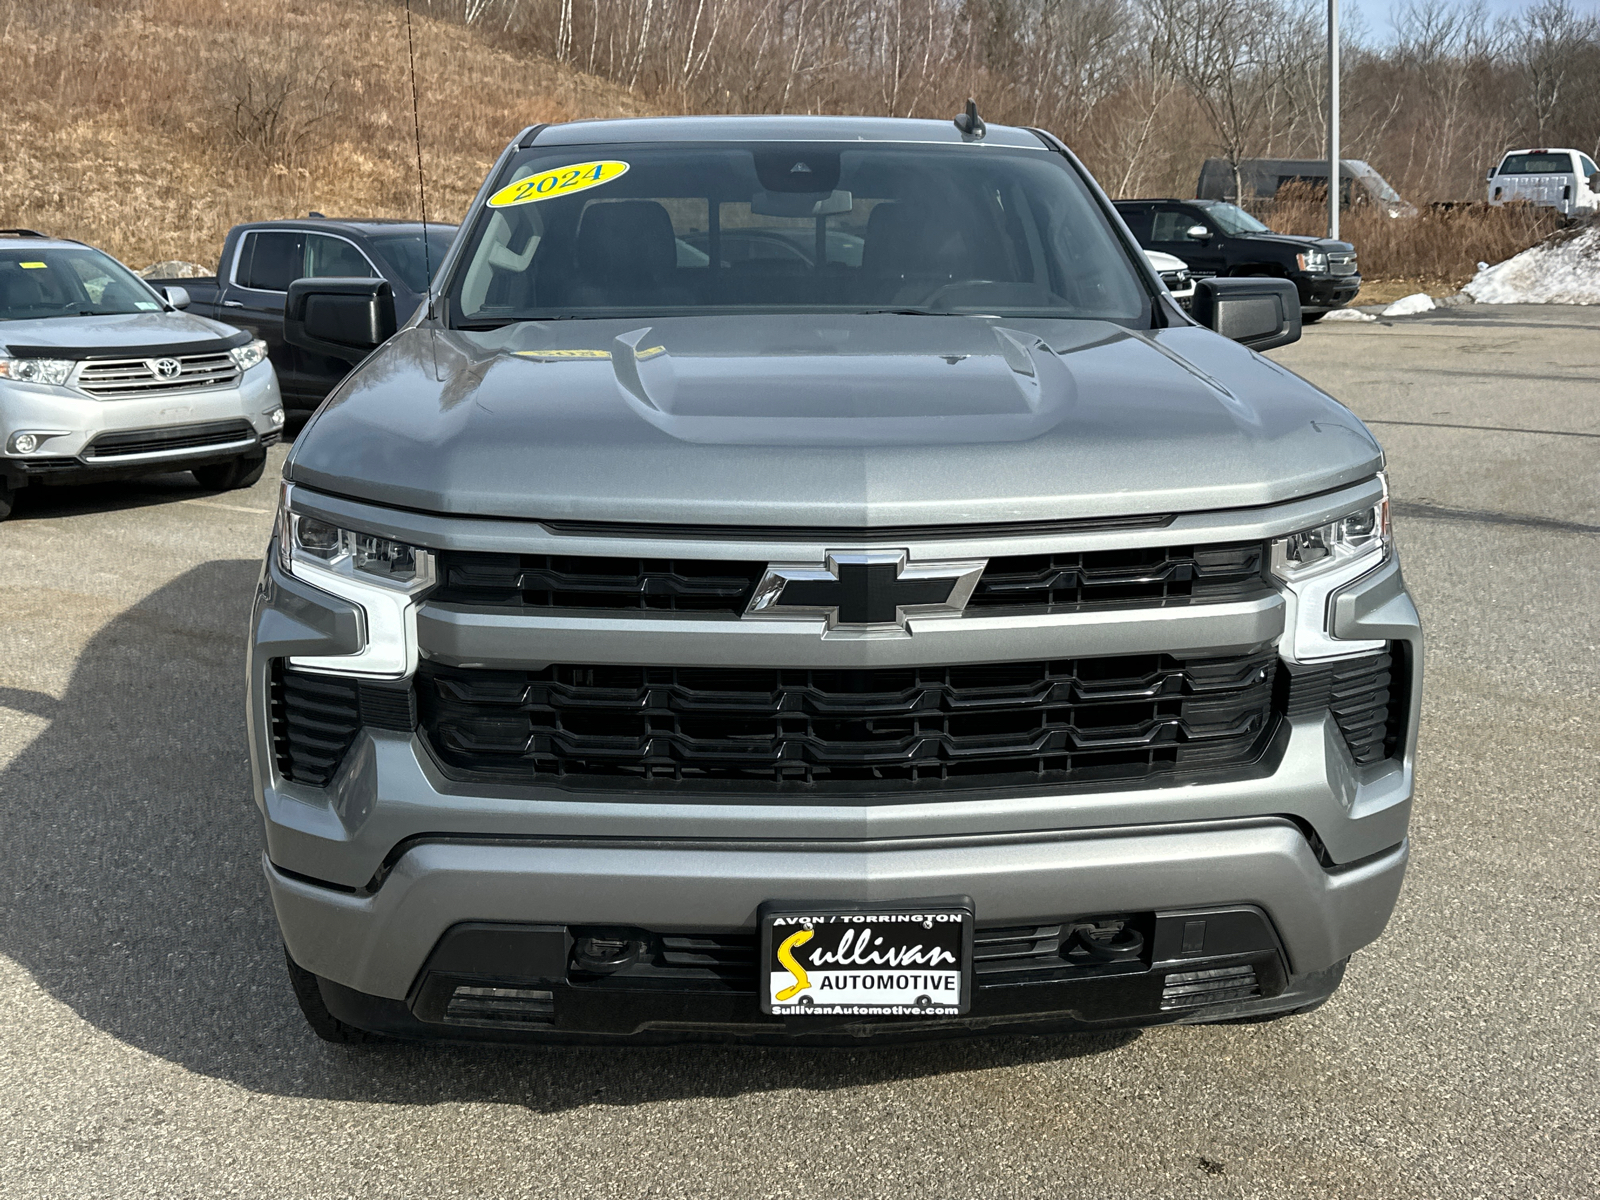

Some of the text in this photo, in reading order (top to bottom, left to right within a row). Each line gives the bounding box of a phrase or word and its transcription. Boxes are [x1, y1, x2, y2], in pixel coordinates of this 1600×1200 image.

[512, 164, 605, 202] 2024
[773, 916, 825, 926] AVON
[841, 914, 963, 923] TORRINGTON
[775, 928, 956, 1001] Sullivan
[819, 975, 956, 991] AUTOMOTIVE
[771, 1005, 959, 1015] SullivanAutomotive.com
